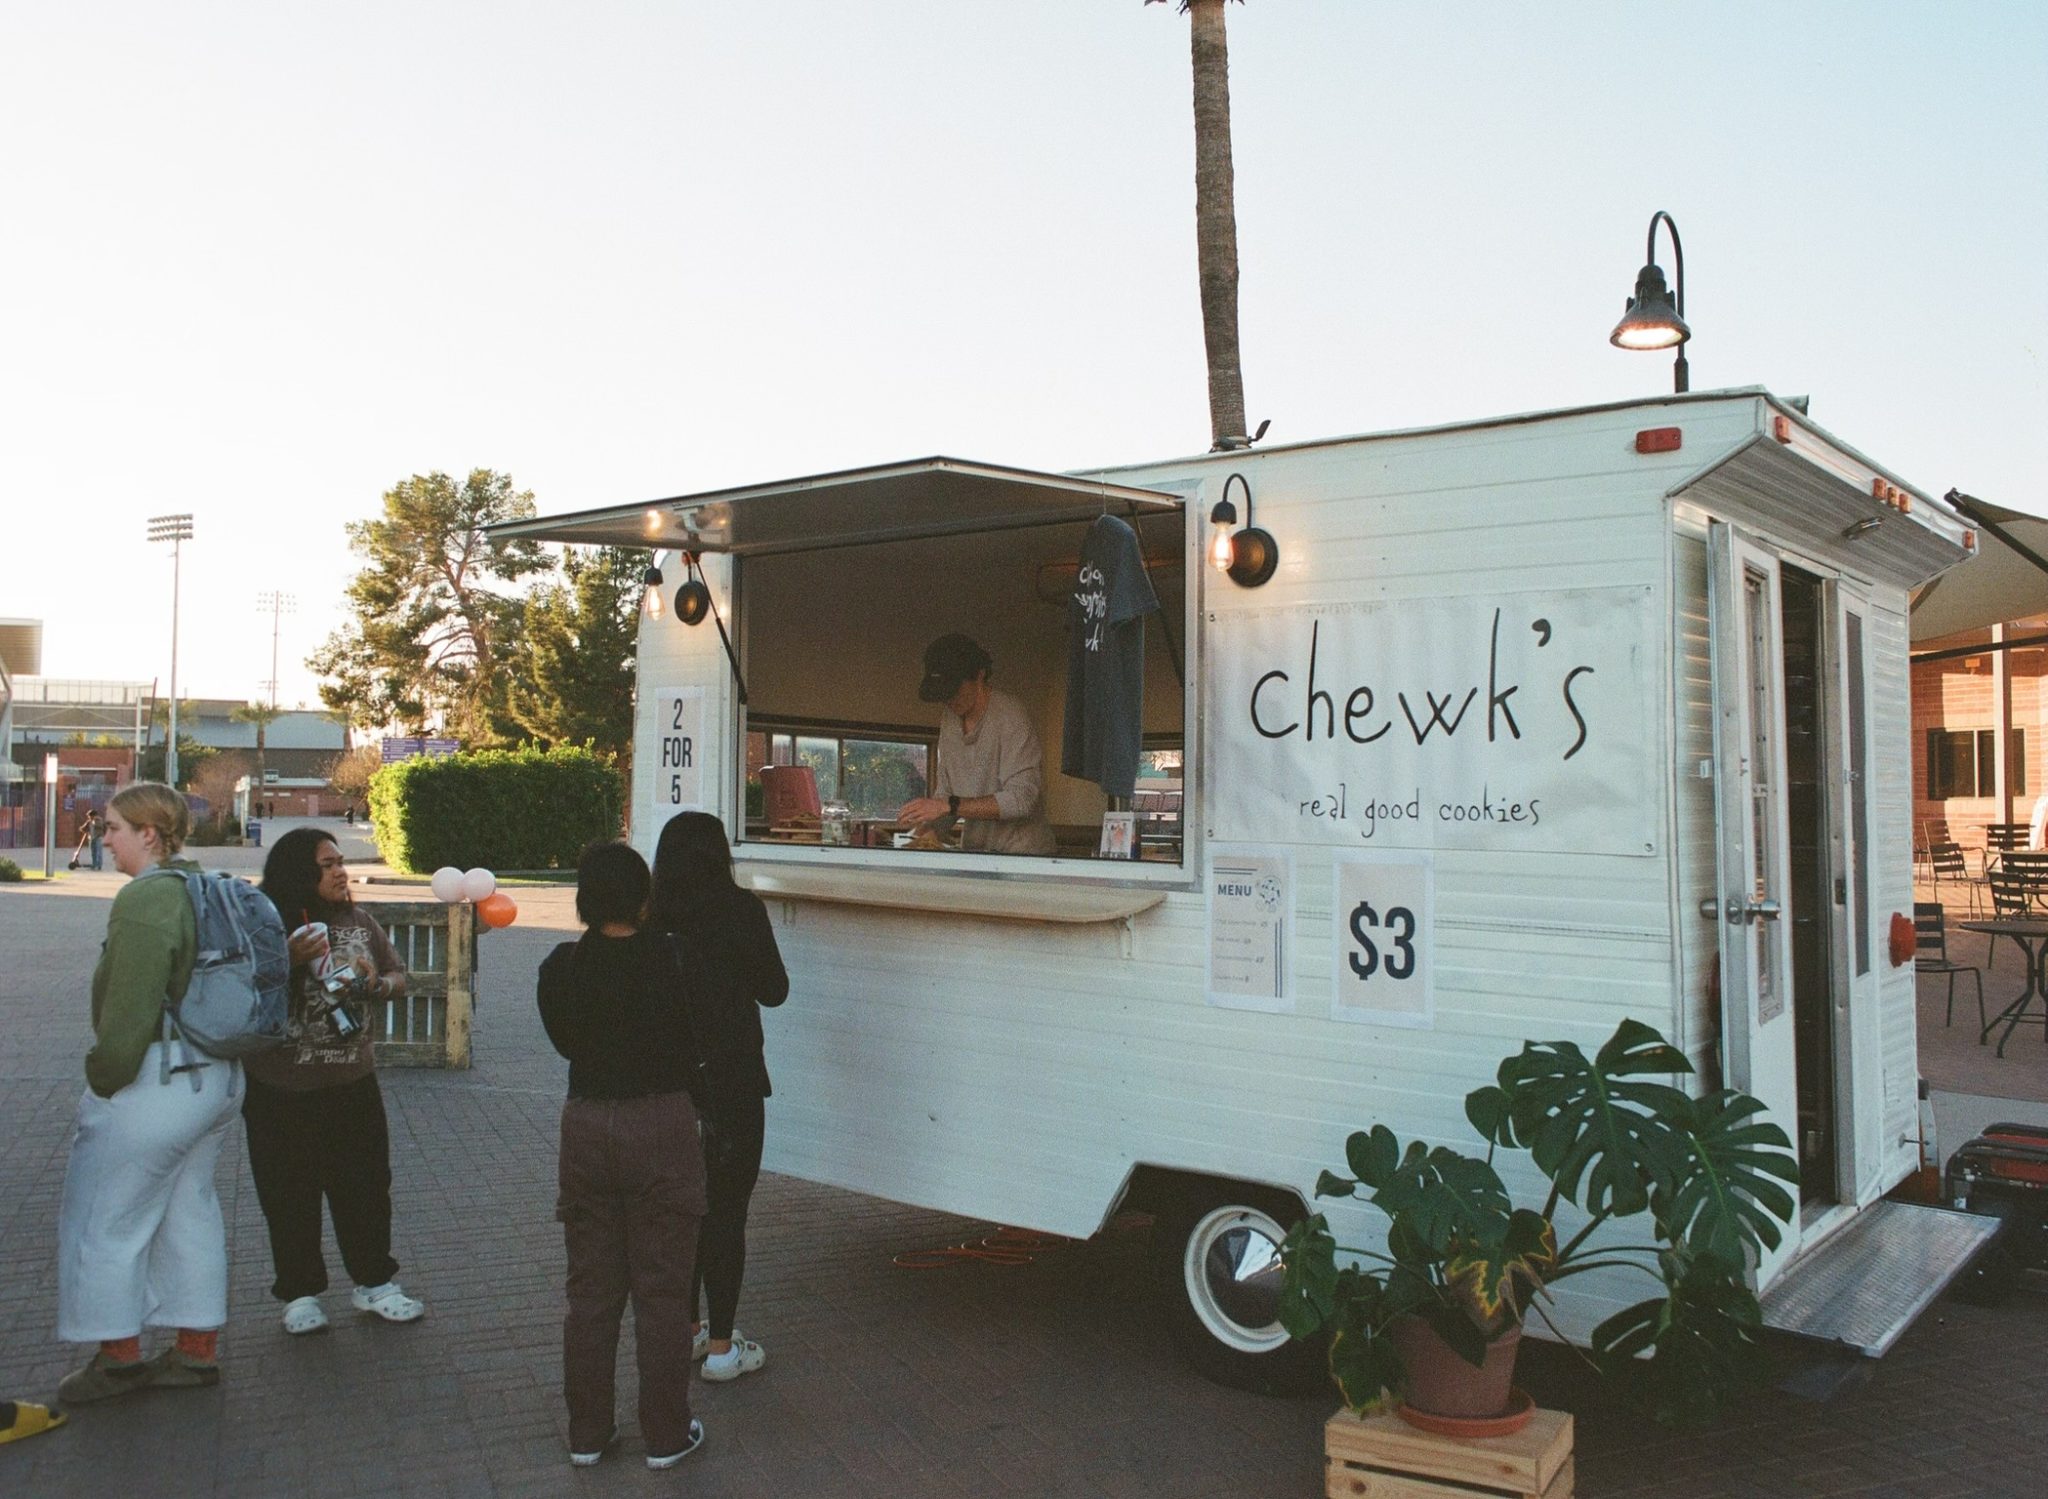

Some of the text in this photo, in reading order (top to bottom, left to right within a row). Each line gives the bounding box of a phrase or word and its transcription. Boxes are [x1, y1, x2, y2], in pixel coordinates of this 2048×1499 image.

[1249, 607, 1595, 761] chewk's
[672, 698, 683, 730] 2
[662, 737, 692, 768] FOR
[671, 774, 681, 805] 5
[1299, 781, 1541, 839] real good cookies
[1217, 883, 1252, 897] MENU
[1348, 900, 1416, 981] $3
